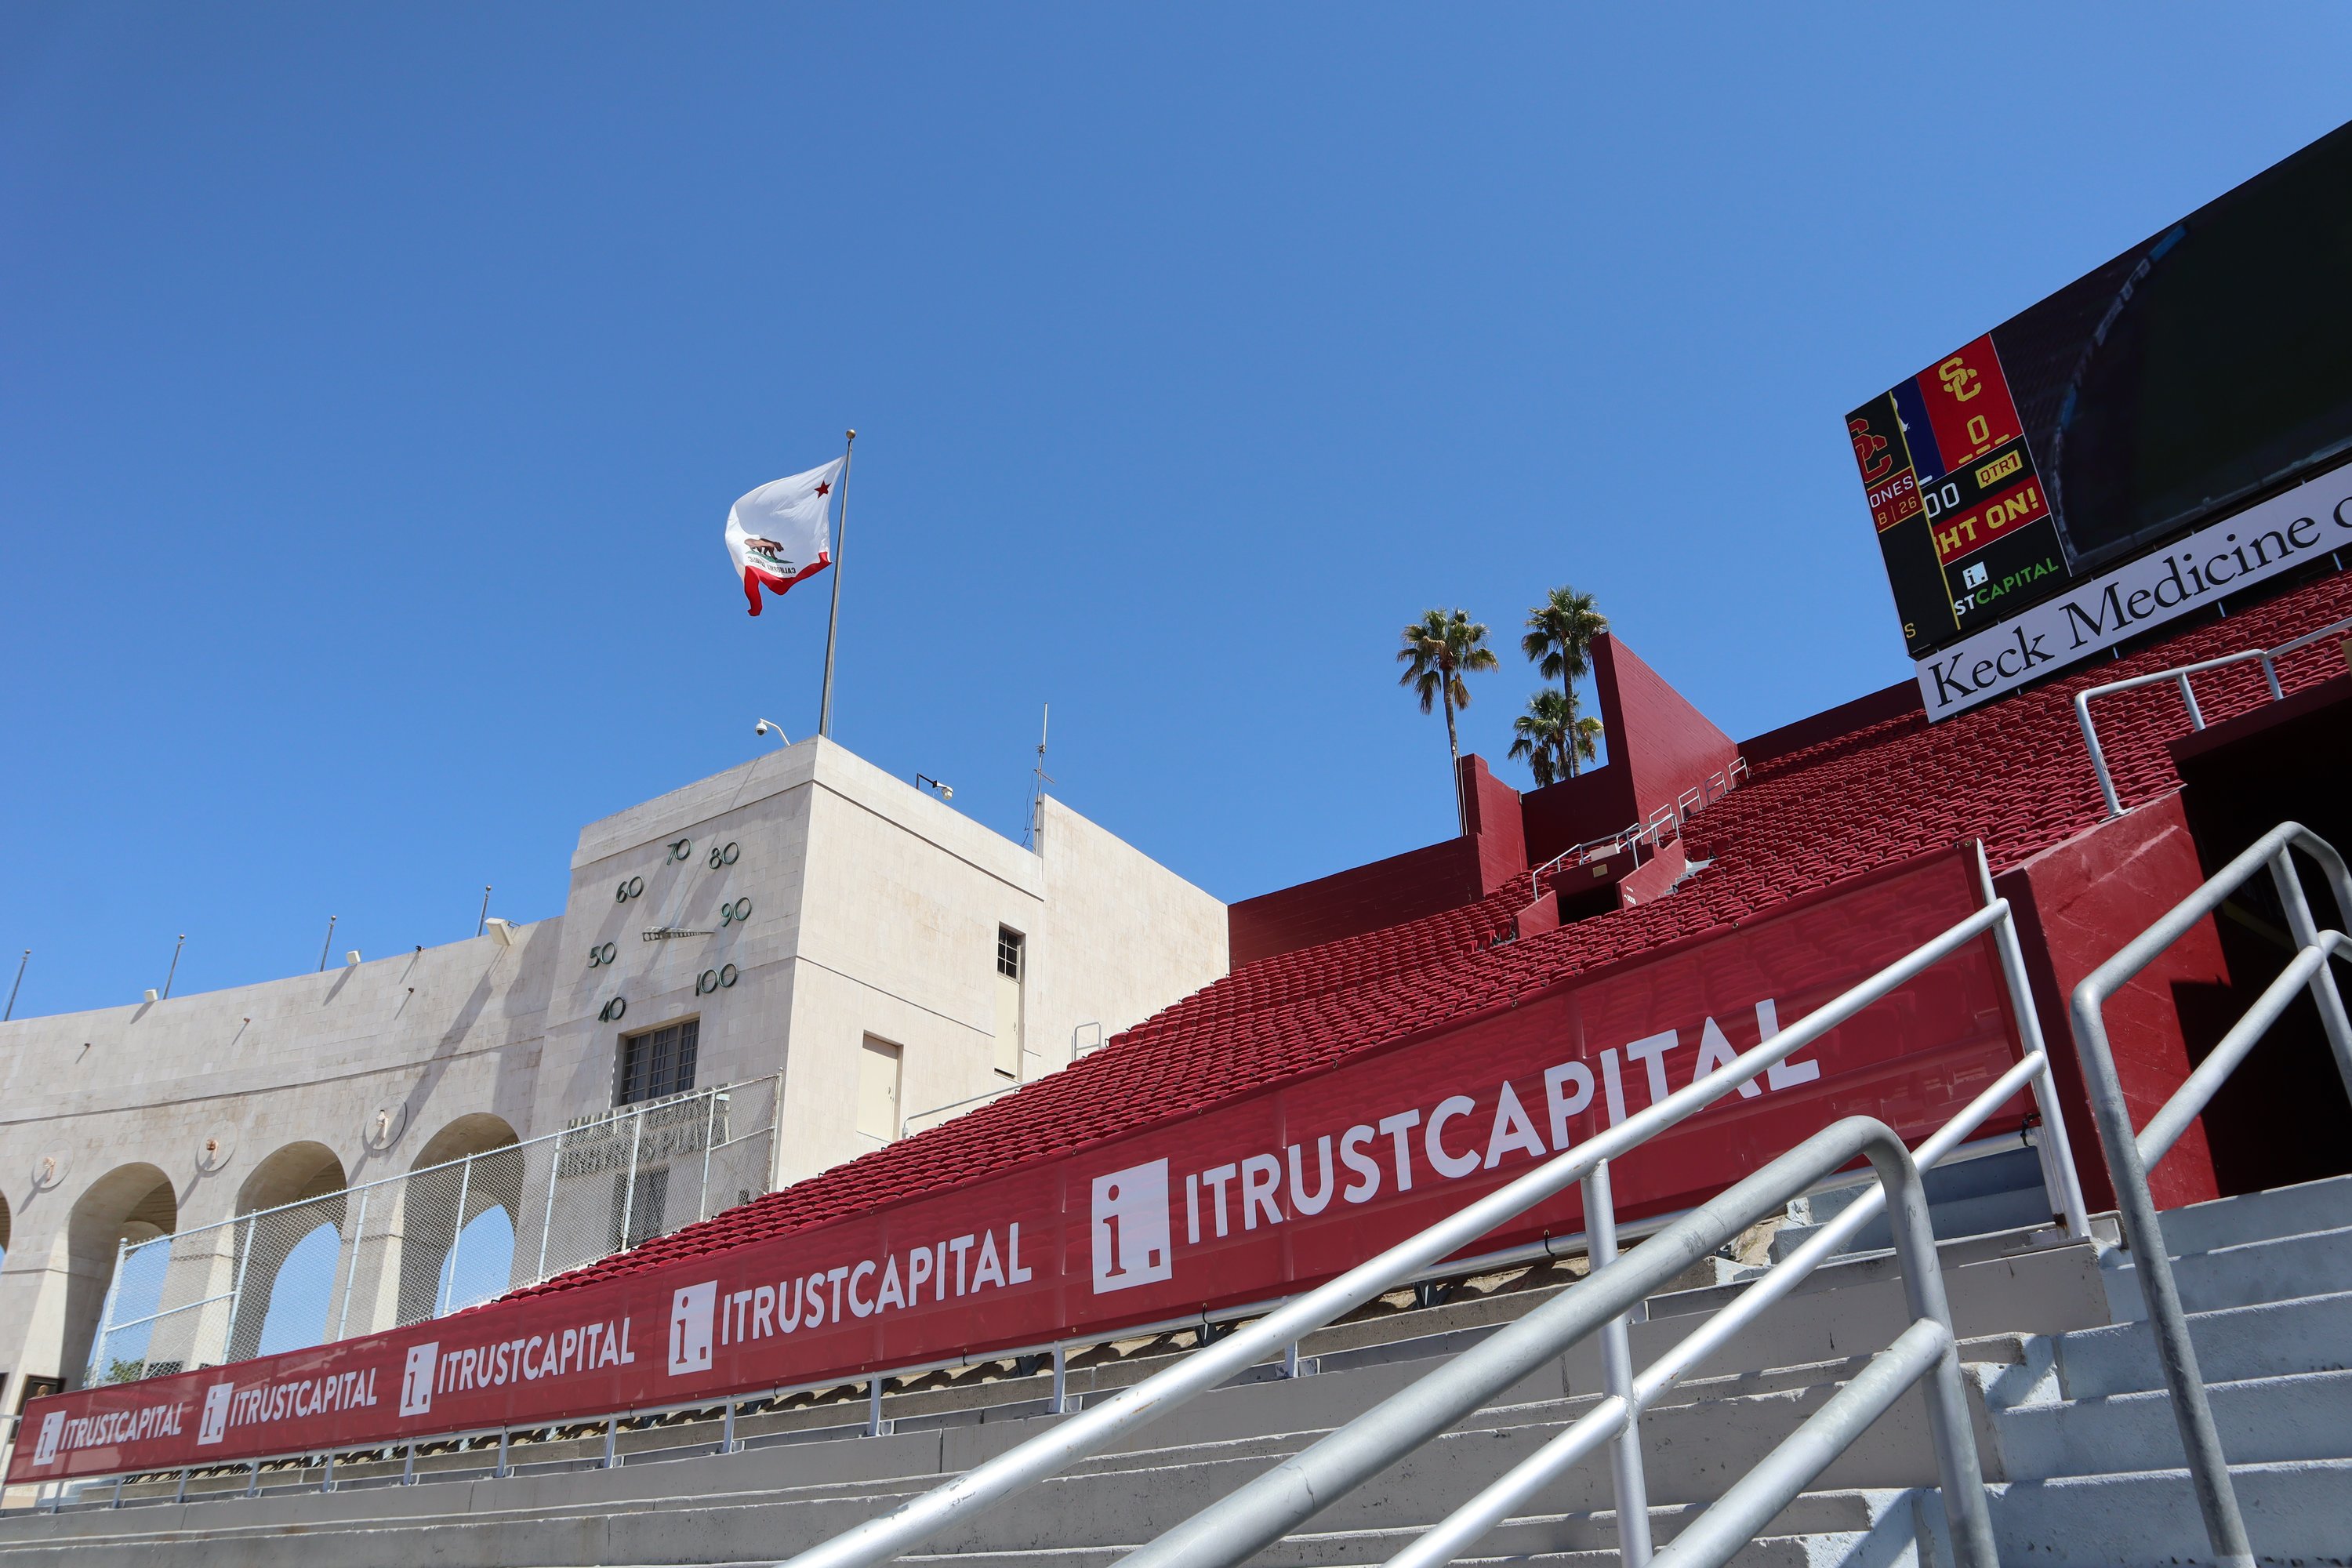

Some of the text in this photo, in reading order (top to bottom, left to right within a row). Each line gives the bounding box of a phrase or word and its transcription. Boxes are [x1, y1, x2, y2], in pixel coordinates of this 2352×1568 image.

[1966, 415, 1991, 445] 0
[1980, 453, 2019, 483] QTR1
[1899, 496, 1917, 514] 26
[1985, 488, 2039, 530] ON!
[1926, 626, 2056, 708] Keck
[2058, 517, 2321, 650] Medicine
[667, 838, 693, 866] 70
[709, 841, 740, 869] 80
[616, 876, 644, 904] 60
[720, 897, 752, 927] 90
[588, 942, 617, 968] 50
[695, 963, 739, 996] 100
[597, 996, 626, 1023] 40
[1185, 998, 1820, 1244] ITRUSTCAPITAL
[721, 1221, 1033, 1346] ITRUSTCAPITAL
[437, 1316, 637, 1395] ITRUSTCAPITAL
[229, 1367, 378, 1428] ITRUSTCAPITAL
[60, 1401, 182, 1451] ITRUSTCAPITAL
